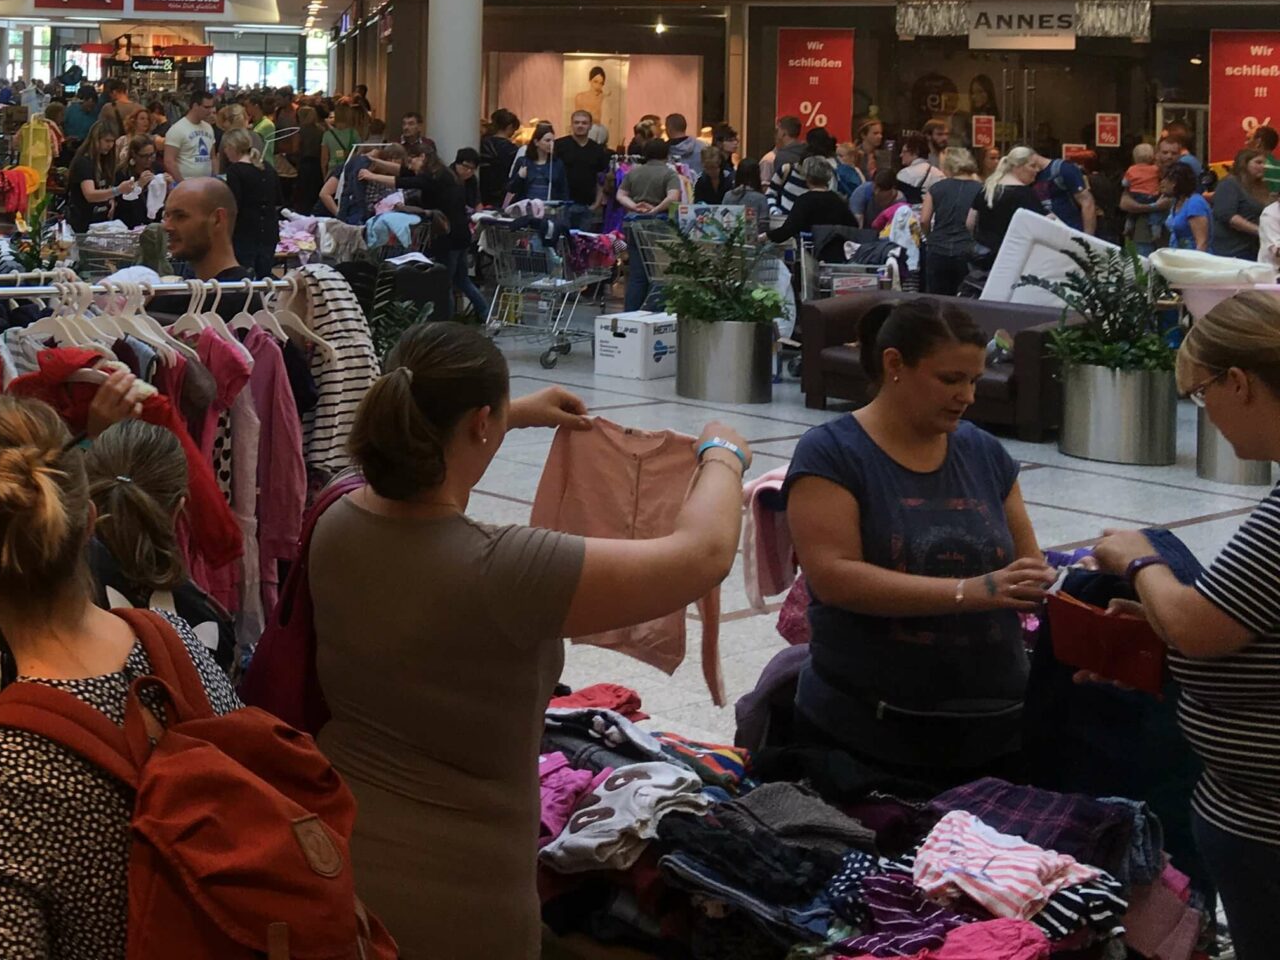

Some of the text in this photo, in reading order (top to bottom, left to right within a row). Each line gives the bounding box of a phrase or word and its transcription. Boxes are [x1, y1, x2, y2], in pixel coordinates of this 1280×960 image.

[974, 11, 1073, 30] ANNES
[806, 41, 824, 50] Wir
[1250, 45, 1274, 56] Wir
[788, 58, 842, 68] schließen
[1225, 64, 1280, 76] schließ
[1254, 86, 1268, 97] !!!
[799, 101, 828, 127] %
